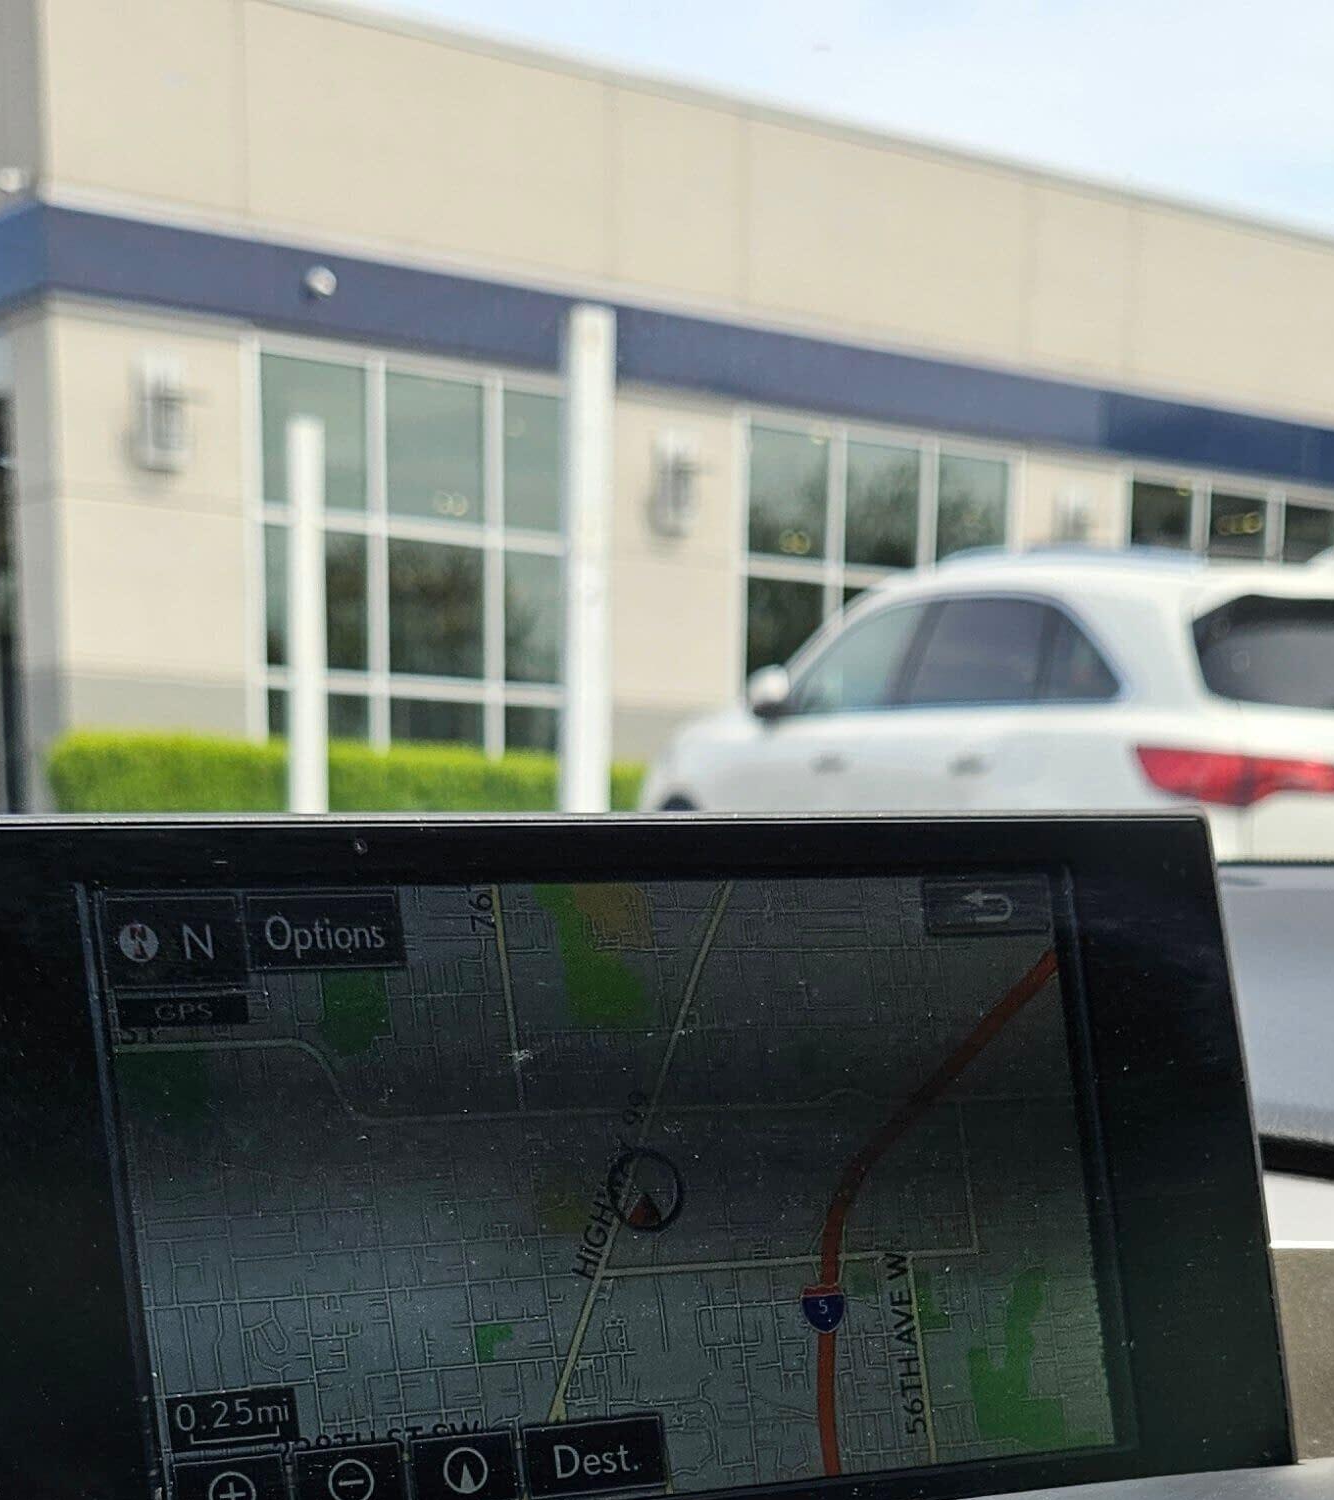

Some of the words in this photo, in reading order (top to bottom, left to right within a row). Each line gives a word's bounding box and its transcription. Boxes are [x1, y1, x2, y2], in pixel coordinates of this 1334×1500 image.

[182, 923, 214, 961] N
[266, 915, 387, 959] Options
[154, 1001, 214, 1021] GPS
[884, 1252, 909, 1281] W
[817, 1298, 829, 1315] 5
[889, 1289, 918, 1346] AVE
[898, 1356, 927, 1434] 56TH
[175, 1397, 290, 1432] 0.25mi
[552, 1442, 641, 1480] Dest.
